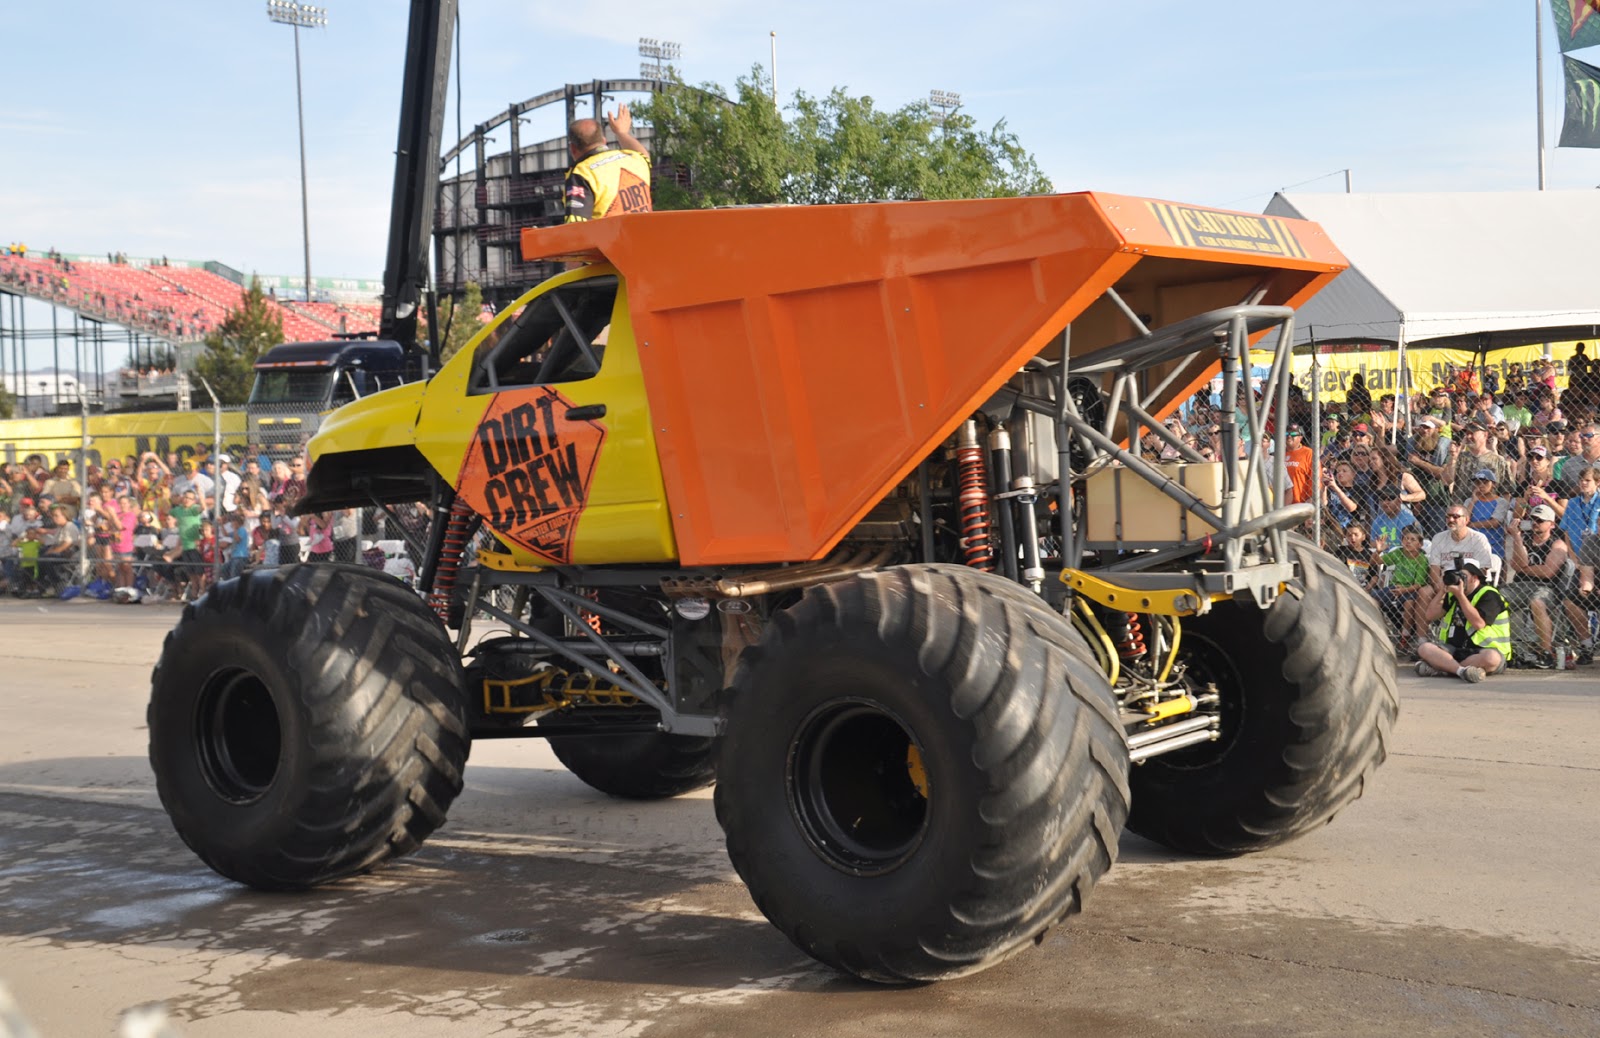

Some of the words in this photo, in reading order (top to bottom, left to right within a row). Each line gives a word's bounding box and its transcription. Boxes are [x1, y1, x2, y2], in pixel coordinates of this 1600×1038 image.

[618, 182, 648, 212] DIRT
[1180, 208, 1272, 240] CAUTION
[478, 394, 559, 478] DIRT
[484, 442, 584, 533] CREW
